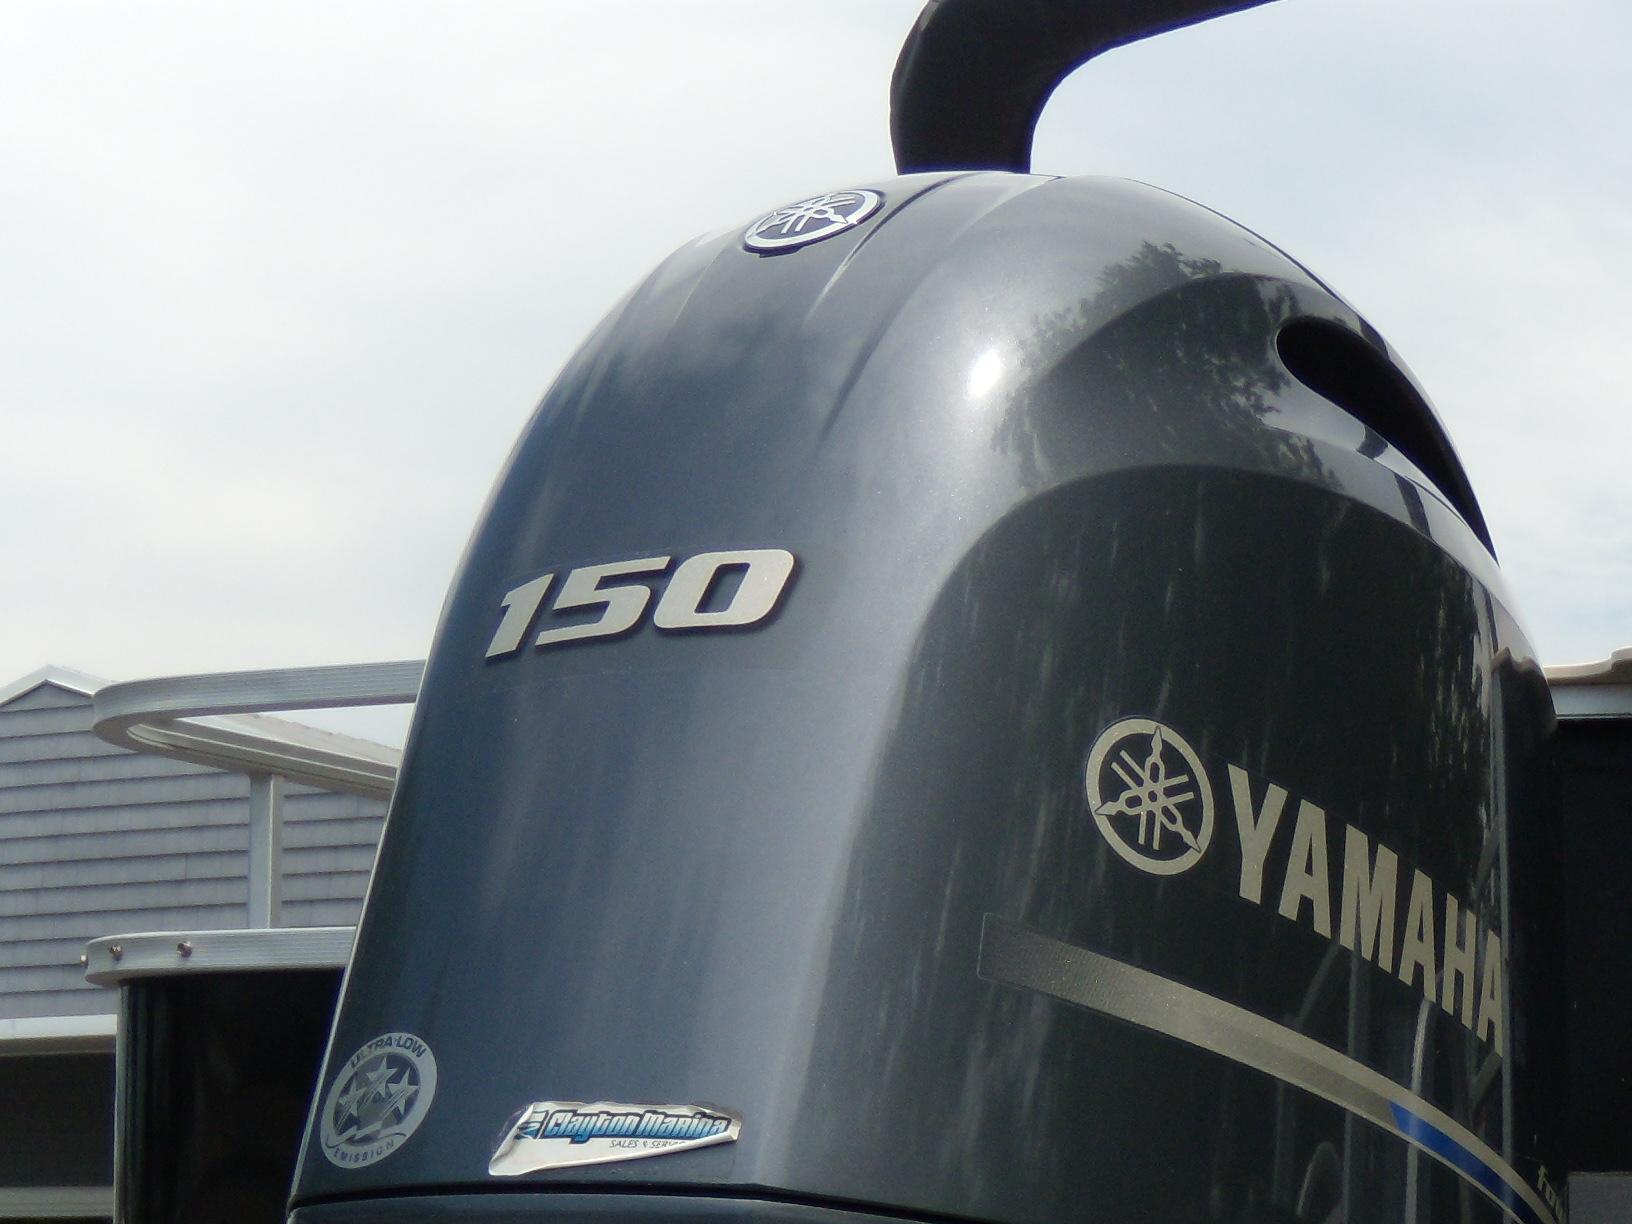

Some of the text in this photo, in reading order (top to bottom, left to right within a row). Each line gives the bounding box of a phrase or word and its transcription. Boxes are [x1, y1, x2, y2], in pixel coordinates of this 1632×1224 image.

[485, 549, 794, 658] 150
[1227, 762, 1503, 1058] YAMAHA
[543, 1110, 641, 1144] Clayton
[609, 1139, 639, 1149] SALES
